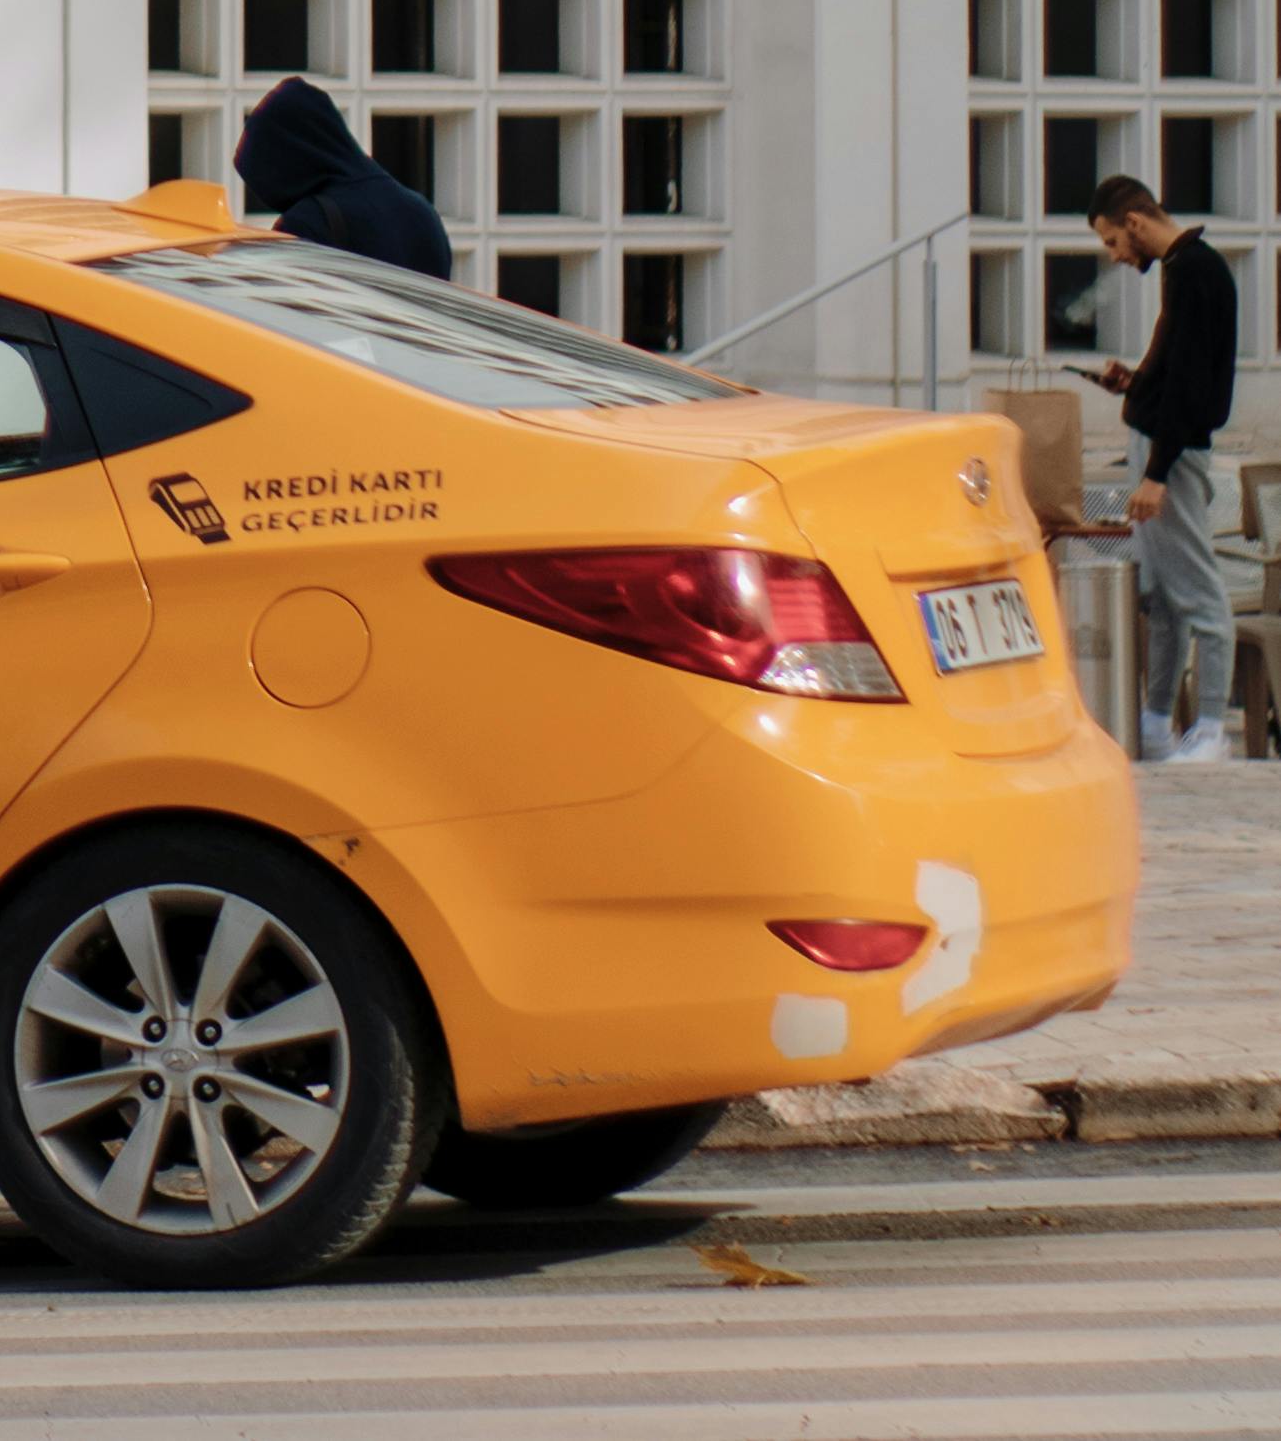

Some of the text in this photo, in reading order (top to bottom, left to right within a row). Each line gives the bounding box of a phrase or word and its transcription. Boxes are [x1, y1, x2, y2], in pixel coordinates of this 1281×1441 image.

[243, 469, 443, 502] KREDİ KARTI
[241, 497, 439, 532] GEÇERLİDİR
